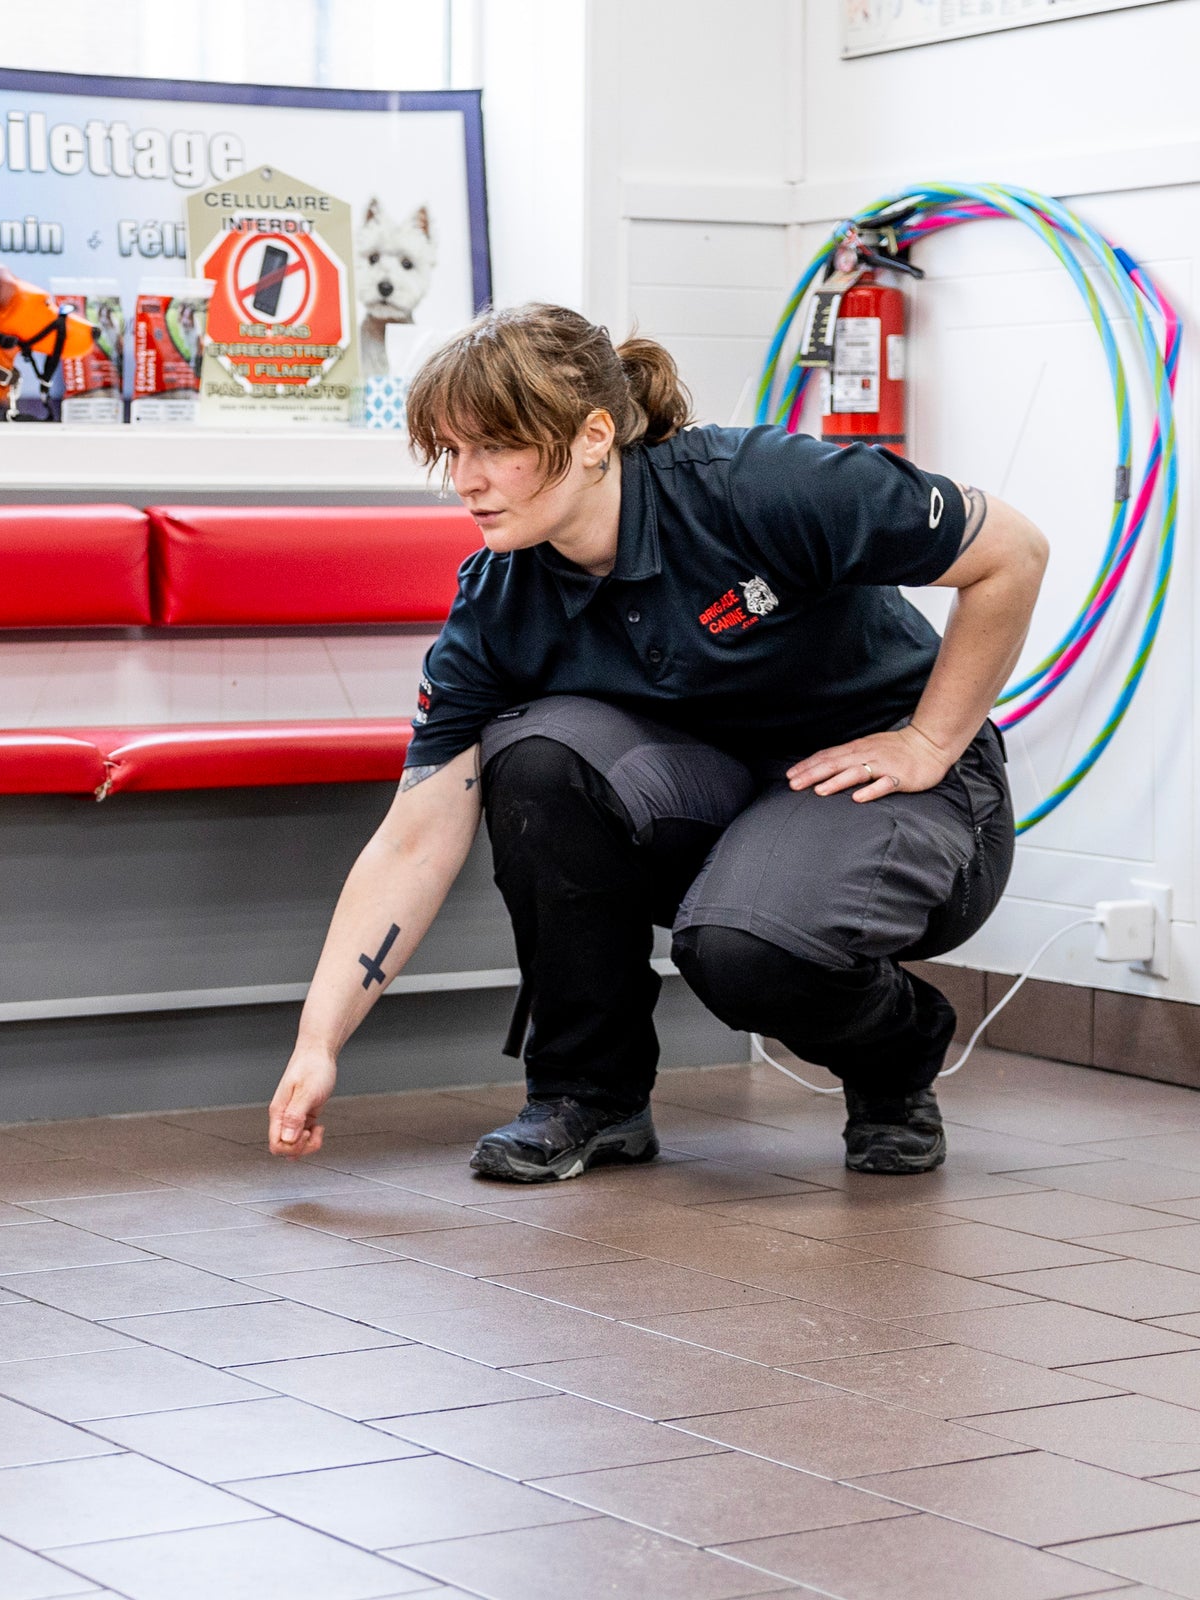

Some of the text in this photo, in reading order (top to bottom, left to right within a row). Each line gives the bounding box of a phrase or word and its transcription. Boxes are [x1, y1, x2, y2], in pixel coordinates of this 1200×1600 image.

[205, 193, 330, 211] CELLULAIRE
[222, 217, 316, 234] INTERDIT
[118, 219, 186, 259] Féli
[240, 324, 311, 339] NE PAS
[207, 344, 344, 359] ENREGISTRER
[254, 363, 325, 378] FILMER
[206, 383, 351, 399] PAS DE PHOTO
[699, 589, 740, 625] BRIGADE
[709, 607, 747, 634] CANINE
